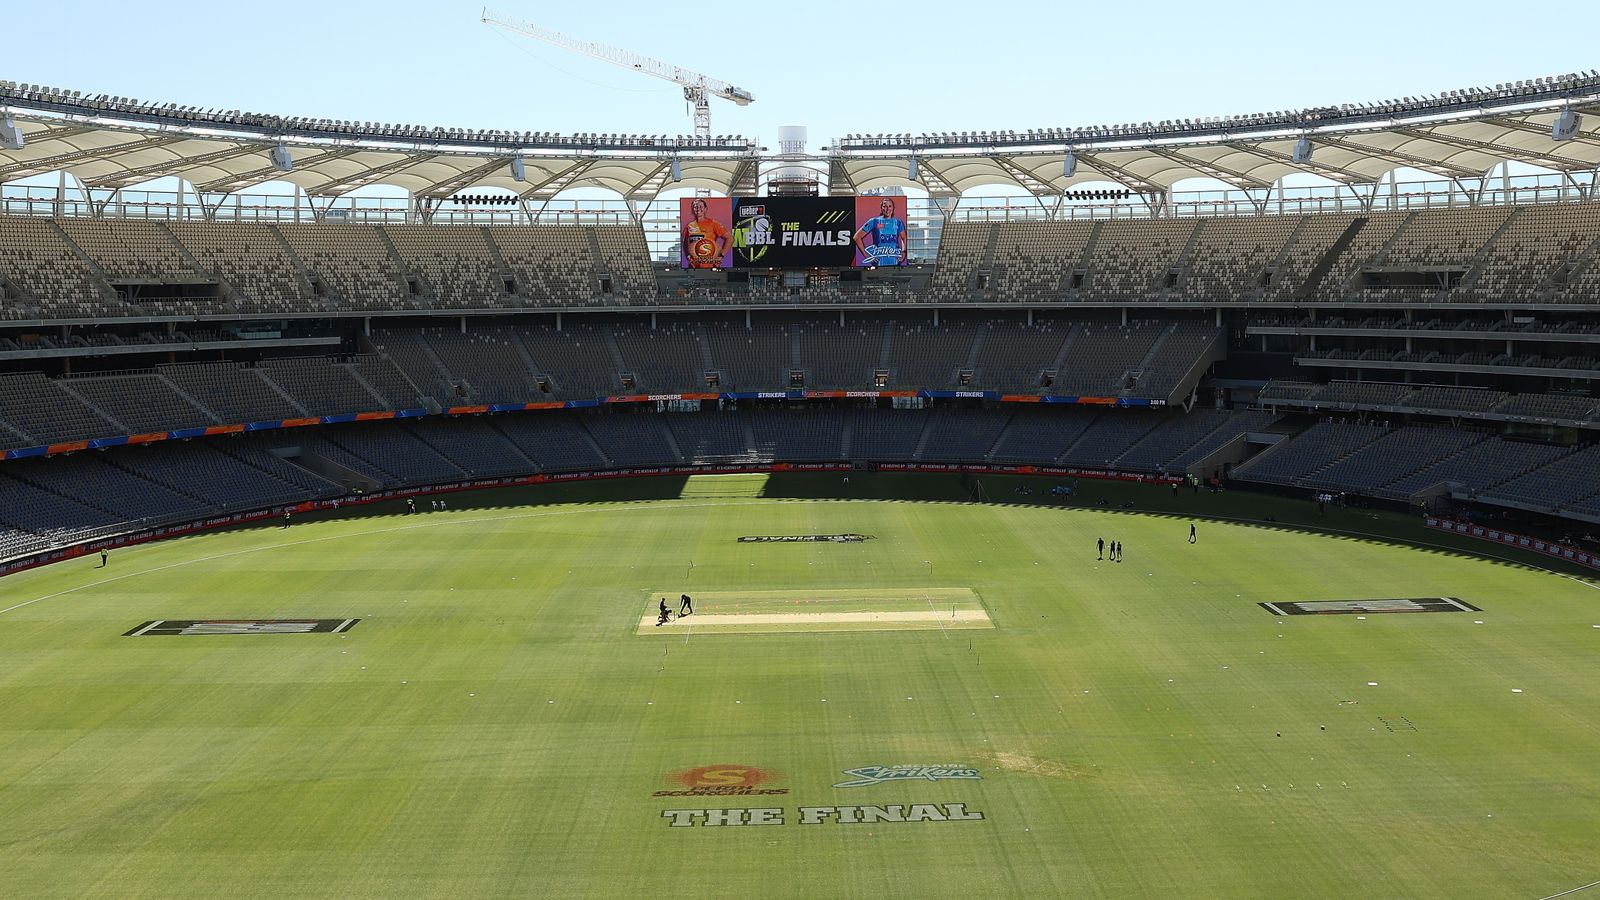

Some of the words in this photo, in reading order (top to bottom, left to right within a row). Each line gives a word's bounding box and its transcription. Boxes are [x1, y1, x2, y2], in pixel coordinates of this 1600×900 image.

[781, 222, 800, 230] THE
[782, 230, 851, 246] FINALS
[832, 764, 984, 788] Strikers
[652, 788, 790, 797] SCORCHERS
[661, 807, 785, 827] THE
[798, 803, 985, 824] FINAL
